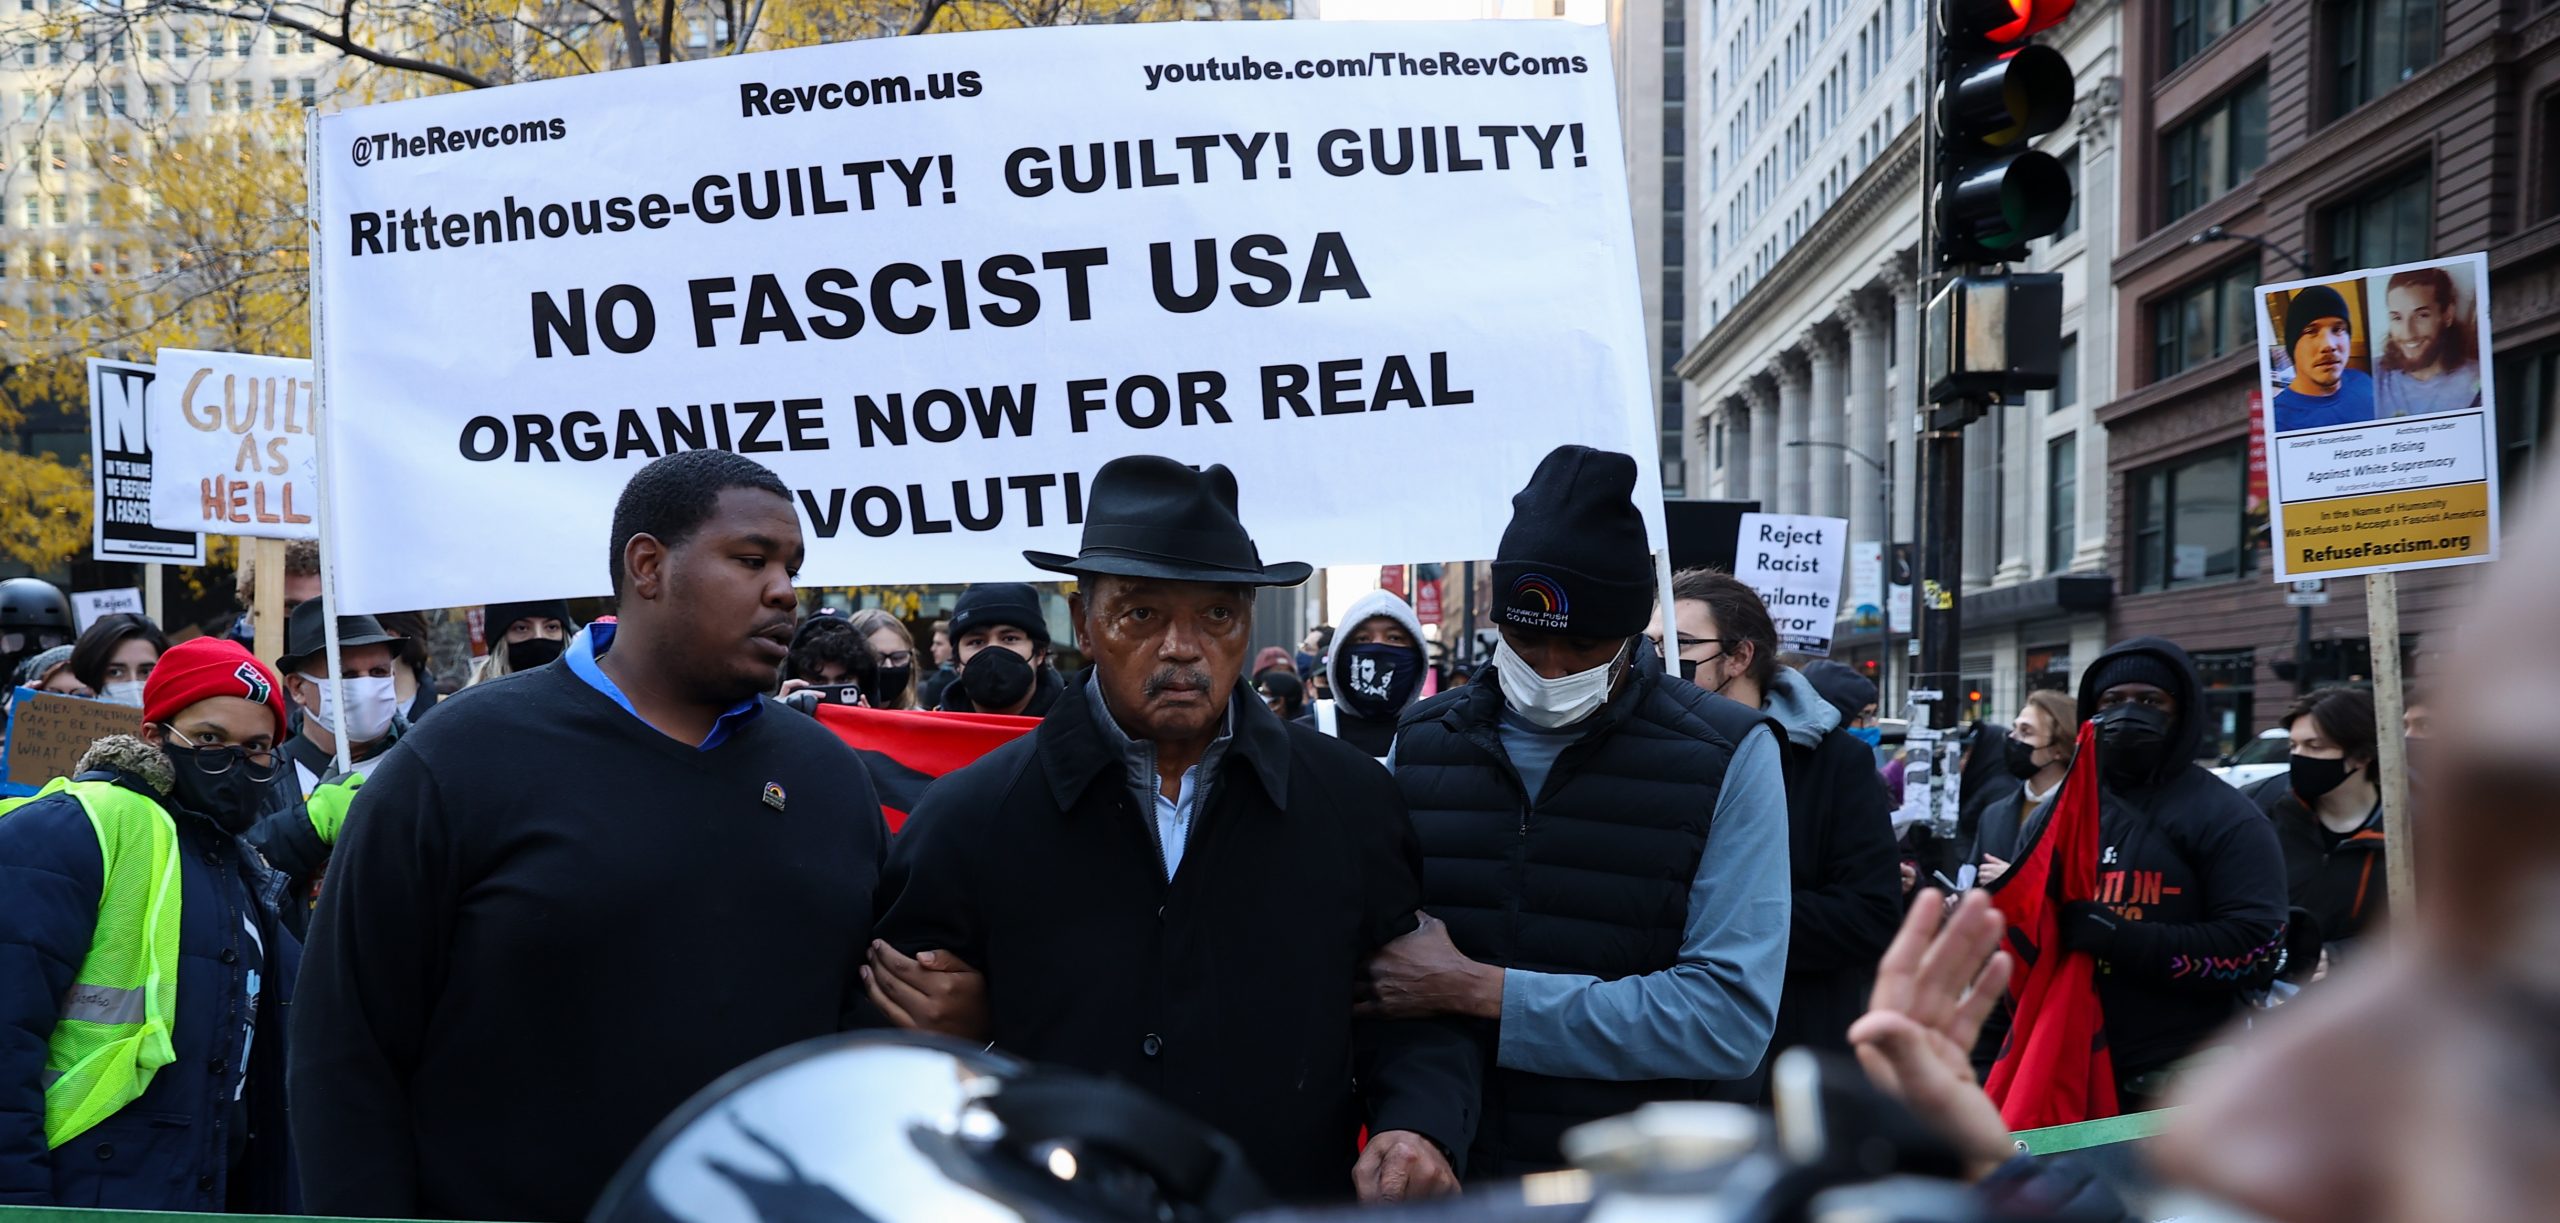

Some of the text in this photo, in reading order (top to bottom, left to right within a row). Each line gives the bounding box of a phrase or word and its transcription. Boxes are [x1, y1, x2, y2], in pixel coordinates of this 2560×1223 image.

[1143, 51, 1588, 91] youtube.com/TheRevComs
[740, 70, 983, 118] Revcom.us
[352, 117, 567, 168] @TheRevcoms
[349, 122, 1588, 257] Rittenhouse-GUILTY! GUILTY! GUILTY!
[531, 231, 1372, 359] NO FASCIST USA
[101, 372, 155, 454] N
[182, 367, 315, 435] GUILT
[459, 351, 1475, 463] ORGANIZE NOW FOR REAL
[2395, 425, 2429, 436] Anthony
[235, 432, 289, 475] AS
[2333, 440, 2426, 460] Heroes in Rising
[115, 461, 130, 476] THE
[2306, 455, 2456, 484] Against White Supremacy
[105, 478, 120, 497] WE
[200, 474, 312, 524] HELL
[789, 465, 1200, 538] VOLUTI
[106, 498, 115, 522] A
[2286, 529, 2302, 538] We
[2303, 525, 2339, 536] Refuse
[2341, 523, 2353, 532] to
[2355, 518, 2391, 530] Accept
[2402, 513, 2440, 525] Fascist
[2442, 508, 2486, 520] America
[2320, 499, 2448, 521] In the Name of Humanity
[1759, 524, 1823, 548] Reject
[2303, 534, 2471, 563] RefuseFascism.org
[1757, 553, 1819, 574] Racist
[1752, 587, 1830, 608] gilante
[1506, 613, 1568, 628] COALITION
[1543, 612, 1569, 621] PUSH
[31, 700, 71, 714] WHEN
[17, 741, 60, 760] WHAT
